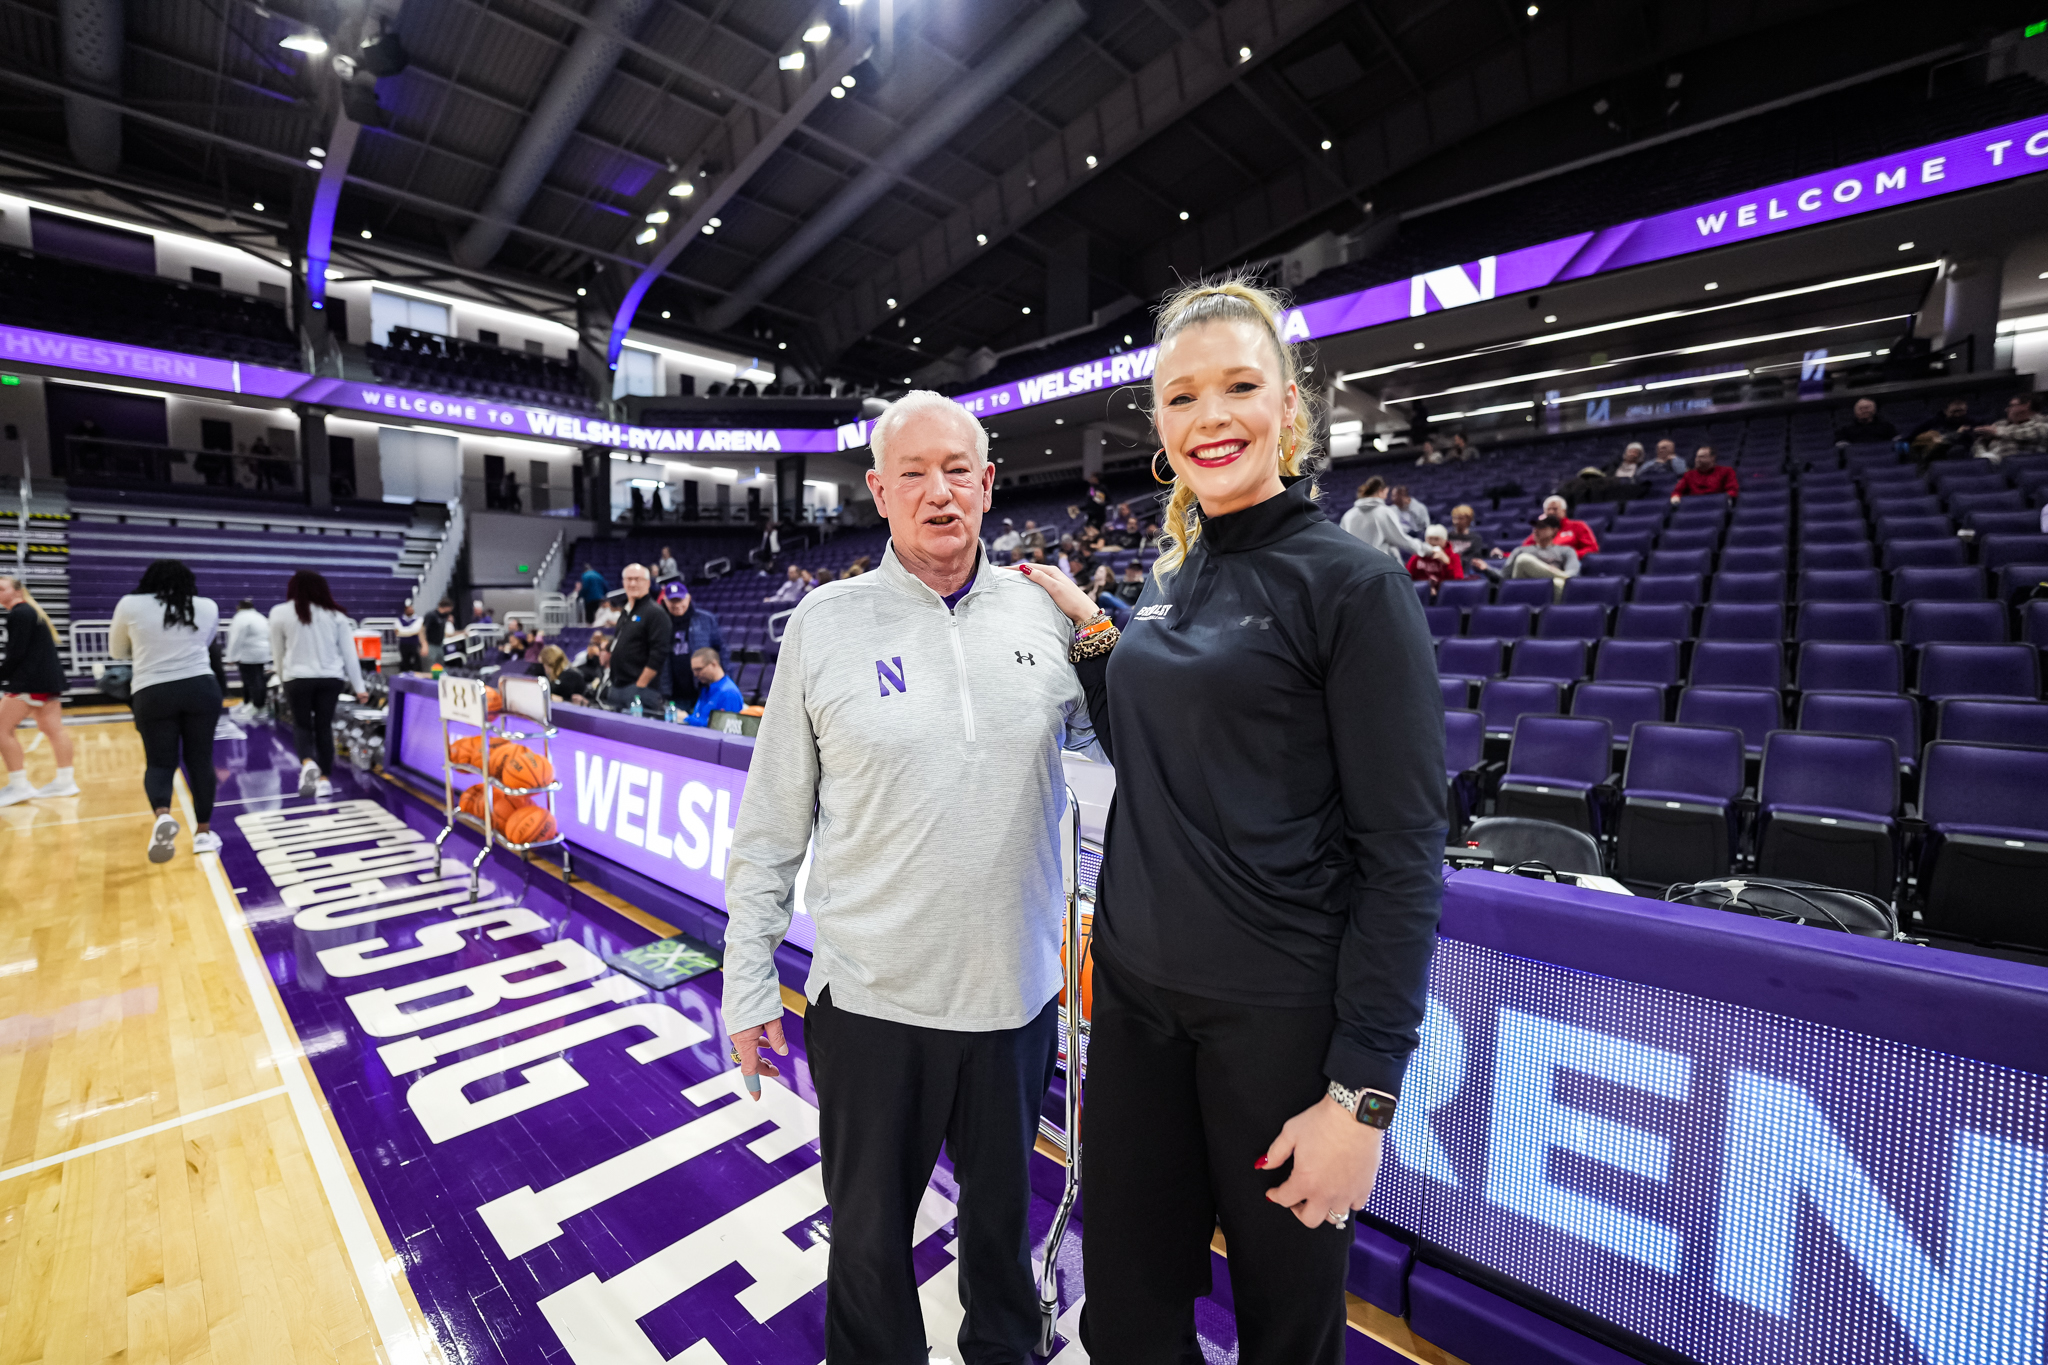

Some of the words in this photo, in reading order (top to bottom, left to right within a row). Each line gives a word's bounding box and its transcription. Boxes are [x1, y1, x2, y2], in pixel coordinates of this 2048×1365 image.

[1695, 155, 1947, 237] WELCOME
[1985, 129, 2048, 167] TO
[1409, 255, 1497, 318] N
[0, 331, 198, 380] HWESTERN
[990, 391, 1011, 408] TO
[1017, 346, 1158, 406] WELSH-RYA
[362, 389, 477, 421] WELCOME
[487, 408, 515, 426] TO
[525, 411, 695, 451] WELSH-RYAN
[697, 429, 782, 452] ARENA
[875, 655, 907, 698] N
[344, 938, 713, 1145] BIG
